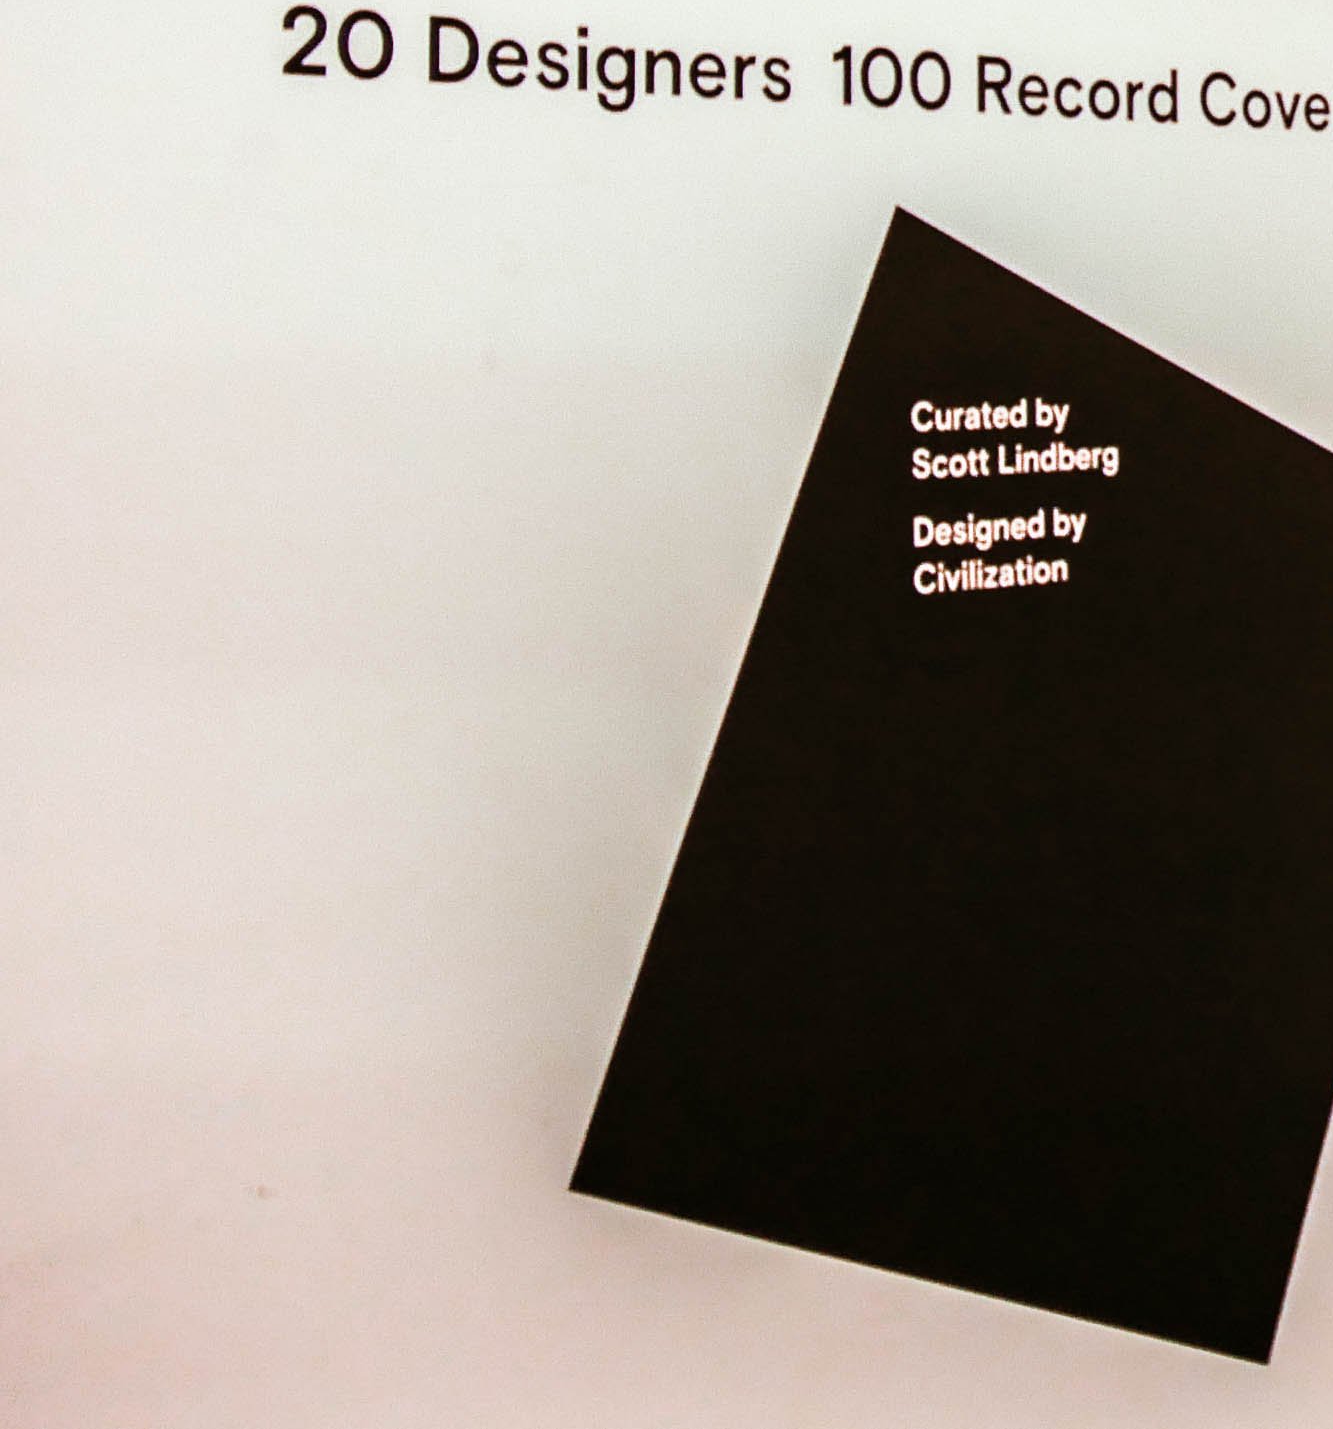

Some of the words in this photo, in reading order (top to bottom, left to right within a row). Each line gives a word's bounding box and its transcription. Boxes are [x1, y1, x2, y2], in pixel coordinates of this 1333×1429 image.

[281, 4, 396, 80] 20
[428, 15, 793, 112] Designers
[832, 45, 952, 112] 100
[977, 57, 1180, 126] Record
[911, 398, 1028, 432] Curated
[1035, 397, 1070, 434] by
[912, 447, 990, 479] Scott
[998, 442, 1120, 478] Lindberg
[913, 507, 1046, 551] Designed
[1053, 507, 1087, 544] by
[913, 554, 1069, 595] Civilization
